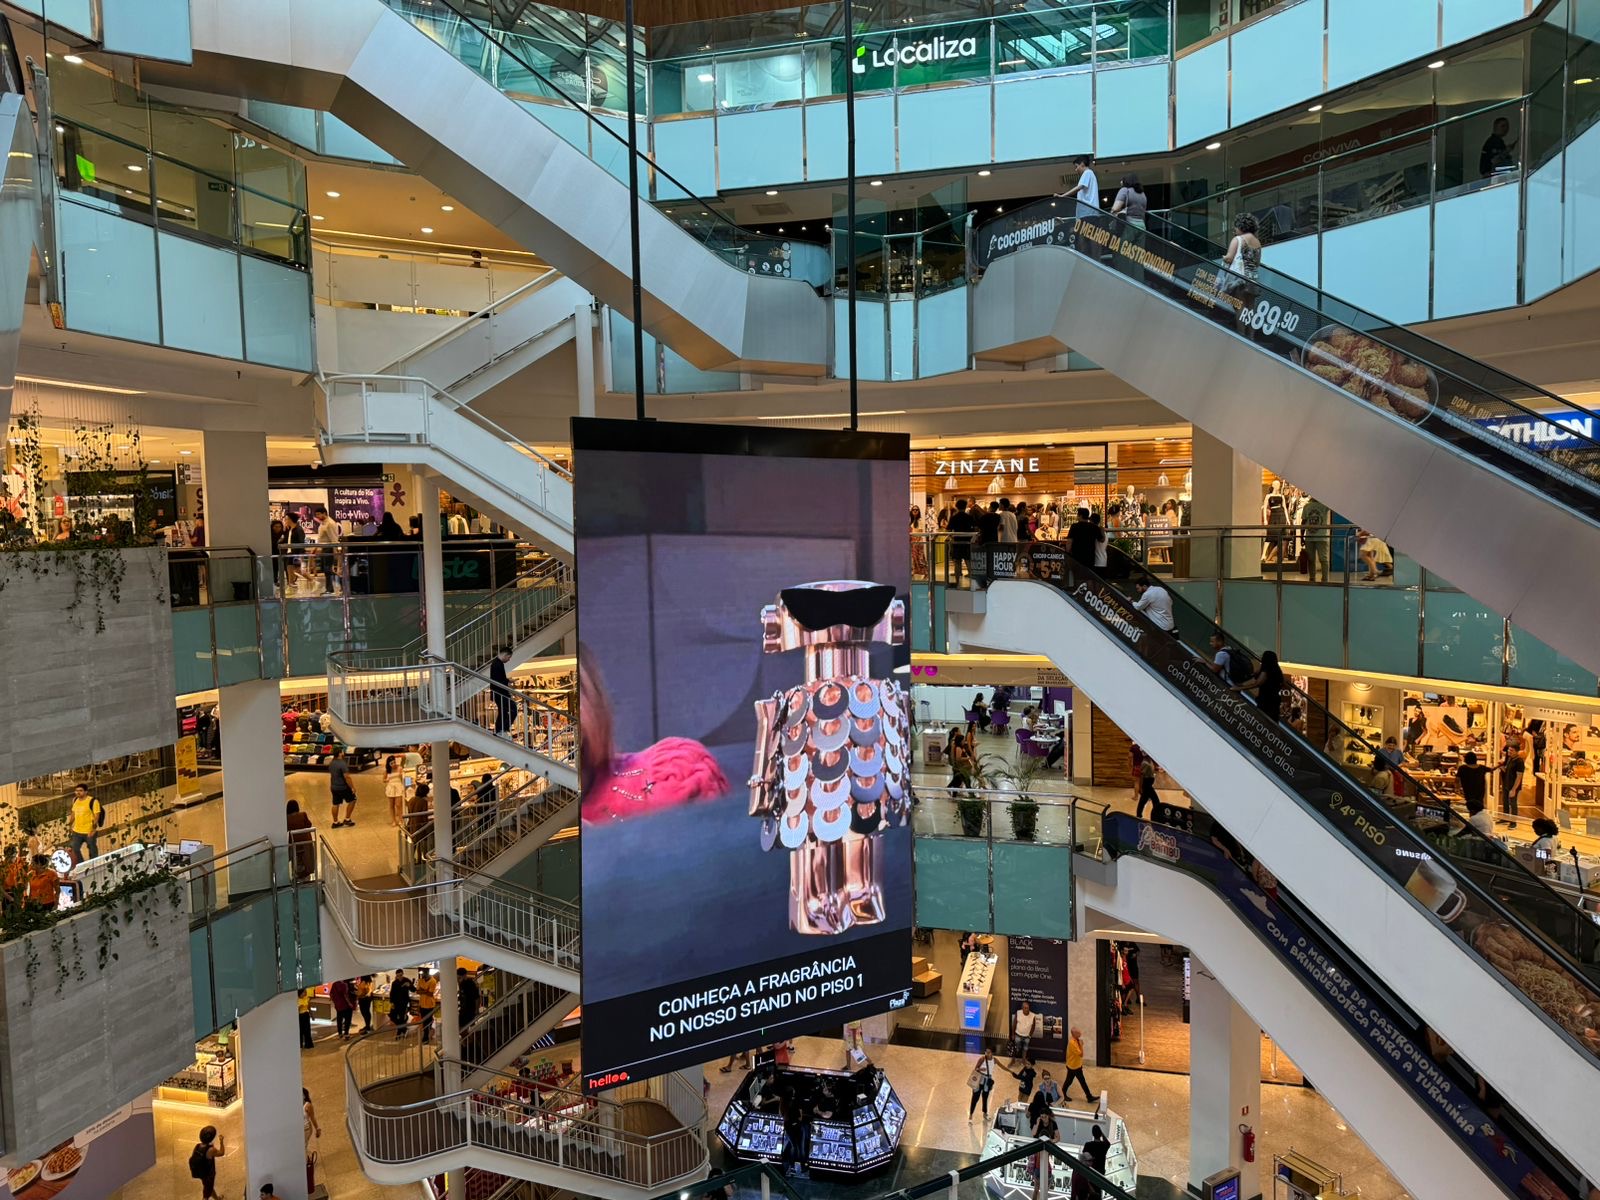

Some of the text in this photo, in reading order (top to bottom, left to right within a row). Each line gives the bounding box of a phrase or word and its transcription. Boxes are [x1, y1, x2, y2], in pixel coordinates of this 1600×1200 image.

[873, 36, 976, 67] Localiza
[1074, 218, 1176, 279] O MELHOR DA GASTRONOMIA
[935, 457, 1040, 475] ZINZANE
[993, 551, 1017, 562] HAPPY
[993, 560, 1014, 572] HOUR
[1167, 664, 1296, 779] com Happy Hour todos os dias.
[1190, 666, 1223, 696] melhor
[1221, 692, 1234, 707] da
[1233, 703, 1293, 756] gastronomia
[1354, 815, 1386, 846] PISO
[650, 973, 864, 1042] NO NOSSO STAND NO PISO 1
[658, 955, 856, 1017] CONHEÇA A FRAGRÂNCIA
[1297, 937, 1451, 1093] O MELHOR DA GASTRONOMIA
[1266, 921, 1476, 1136] COM BRINQUEDOTECA PARA A TURMINHA
